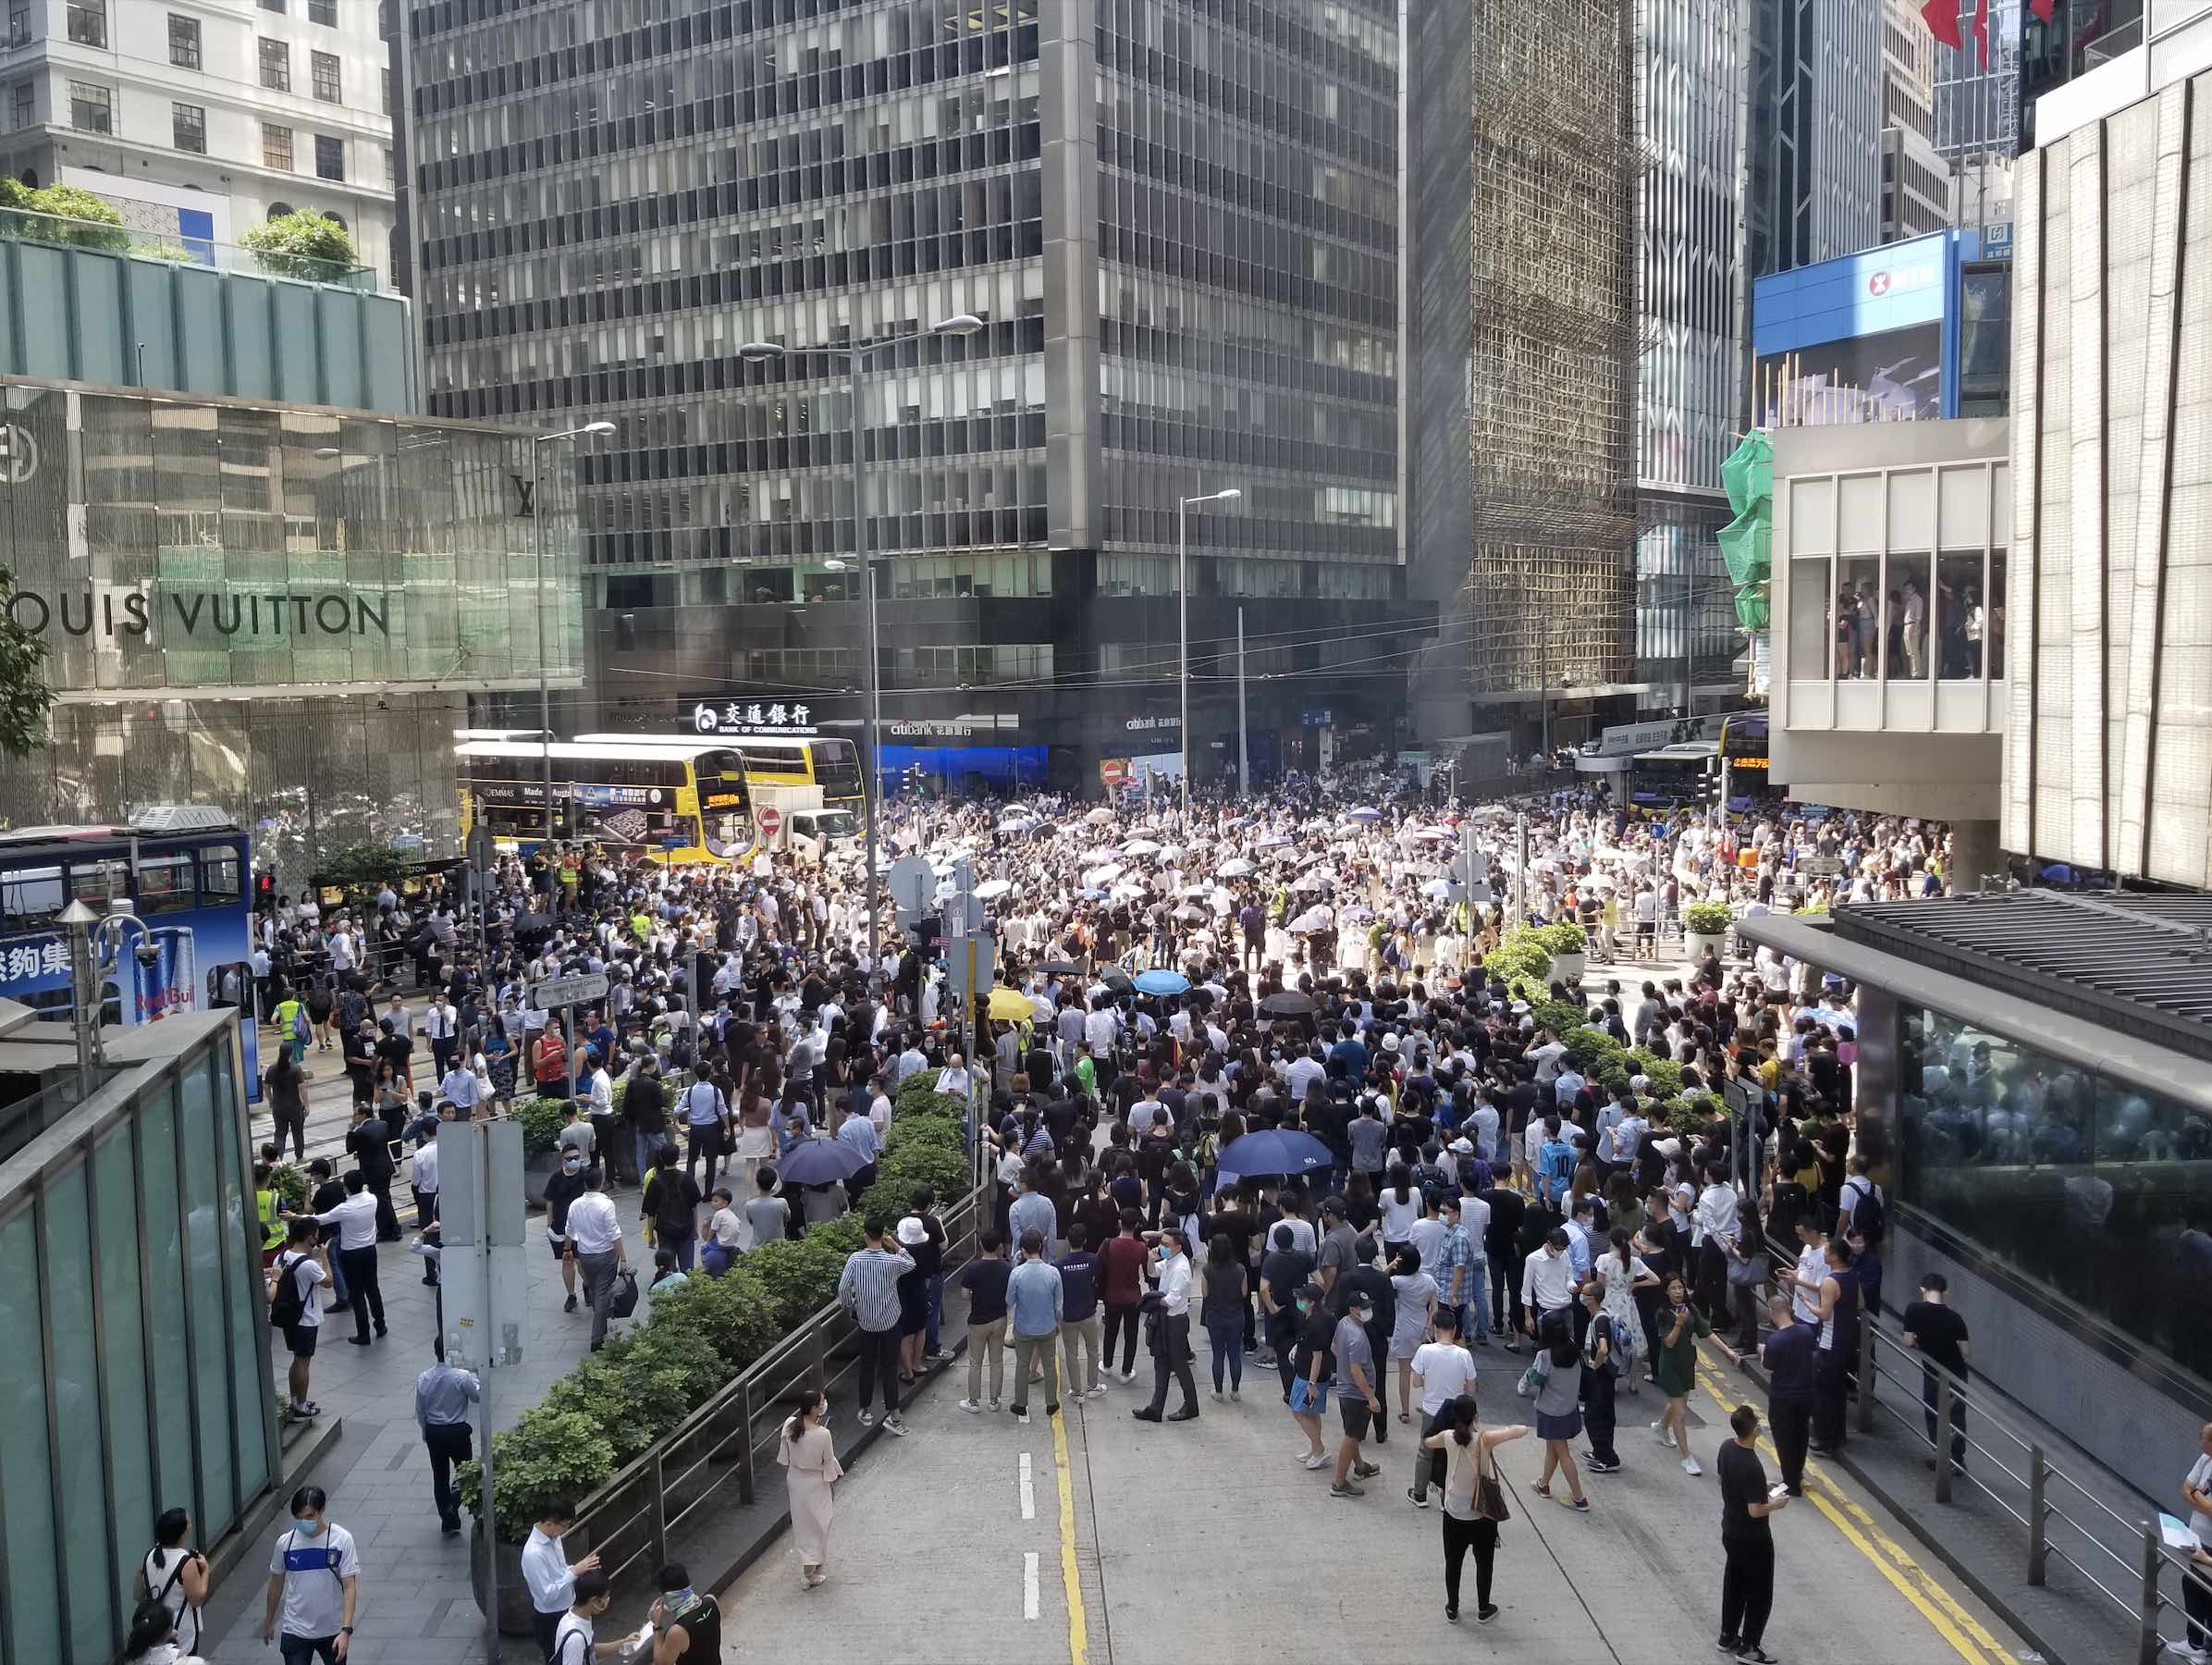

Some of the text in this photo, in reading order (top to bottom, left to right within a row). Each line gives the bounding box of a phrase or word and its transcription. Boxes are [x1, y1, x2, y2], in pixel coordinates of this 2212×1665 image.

[6, 591, 389, 636] OUIS VUITTON
[726, 702, 811, 725] 交通銀行
[891, 722, 932, 735] citibank
[524, 787, 543, 796] Made
[552, 788, 583, 798] Austrlia
[1555, 1154, 1569, 1178] 10
